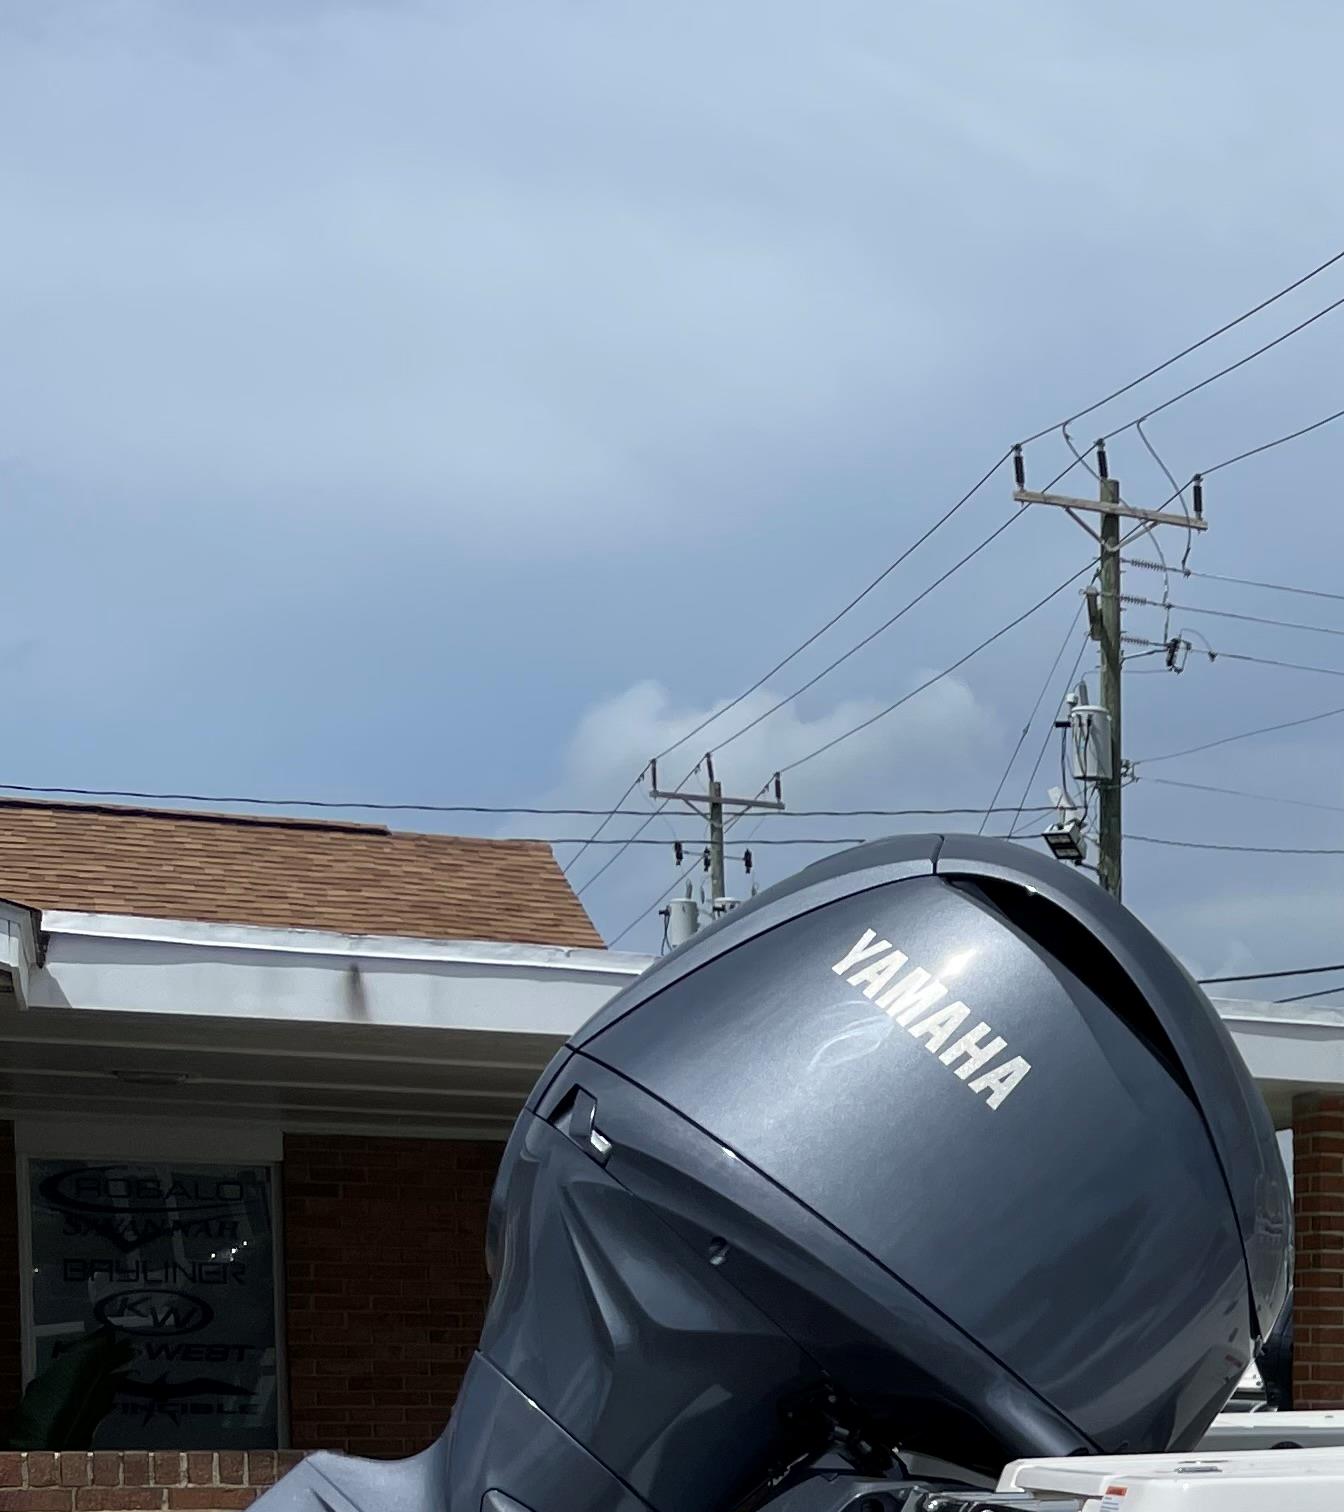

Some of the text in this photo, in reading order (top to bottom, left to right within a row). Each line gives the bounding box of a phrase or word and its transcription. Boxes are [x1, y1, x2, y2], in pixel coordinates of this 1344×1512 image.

[832, 928, 1031, 1111] YAMAHA
[74, 1177, 245, 1202] ROBALO
[62, 1258, 248, 1285] BAYLINER
